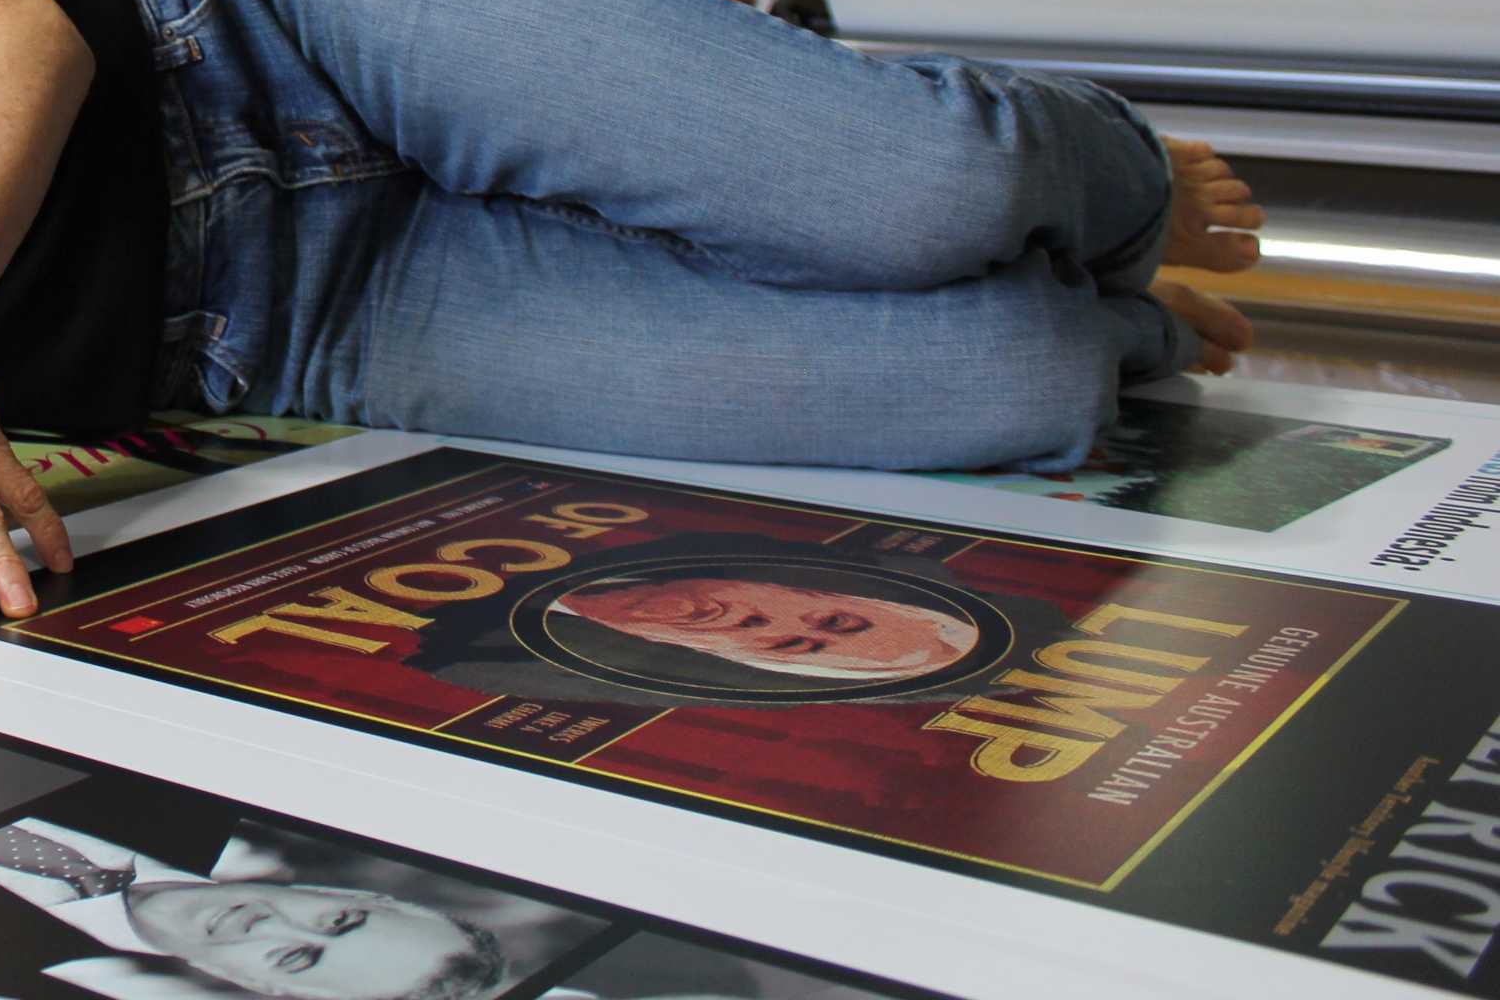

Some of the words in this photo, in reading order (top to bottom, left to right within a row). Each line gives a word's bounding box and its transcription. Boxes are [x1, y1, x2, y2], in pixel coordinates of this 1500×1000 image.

[519, 501, 650, 539] OF
[1369, 502, 1500, 572] Indonesia:
[207, 536, 572, 656] COAL
[921, 602, 1251, 783] LUMP
[1217, 625, 1319, 695] GENUINE
[531, 711, 572, 728] LIKE
[1087, 691, 1233, 806] AUSTRALIAN
